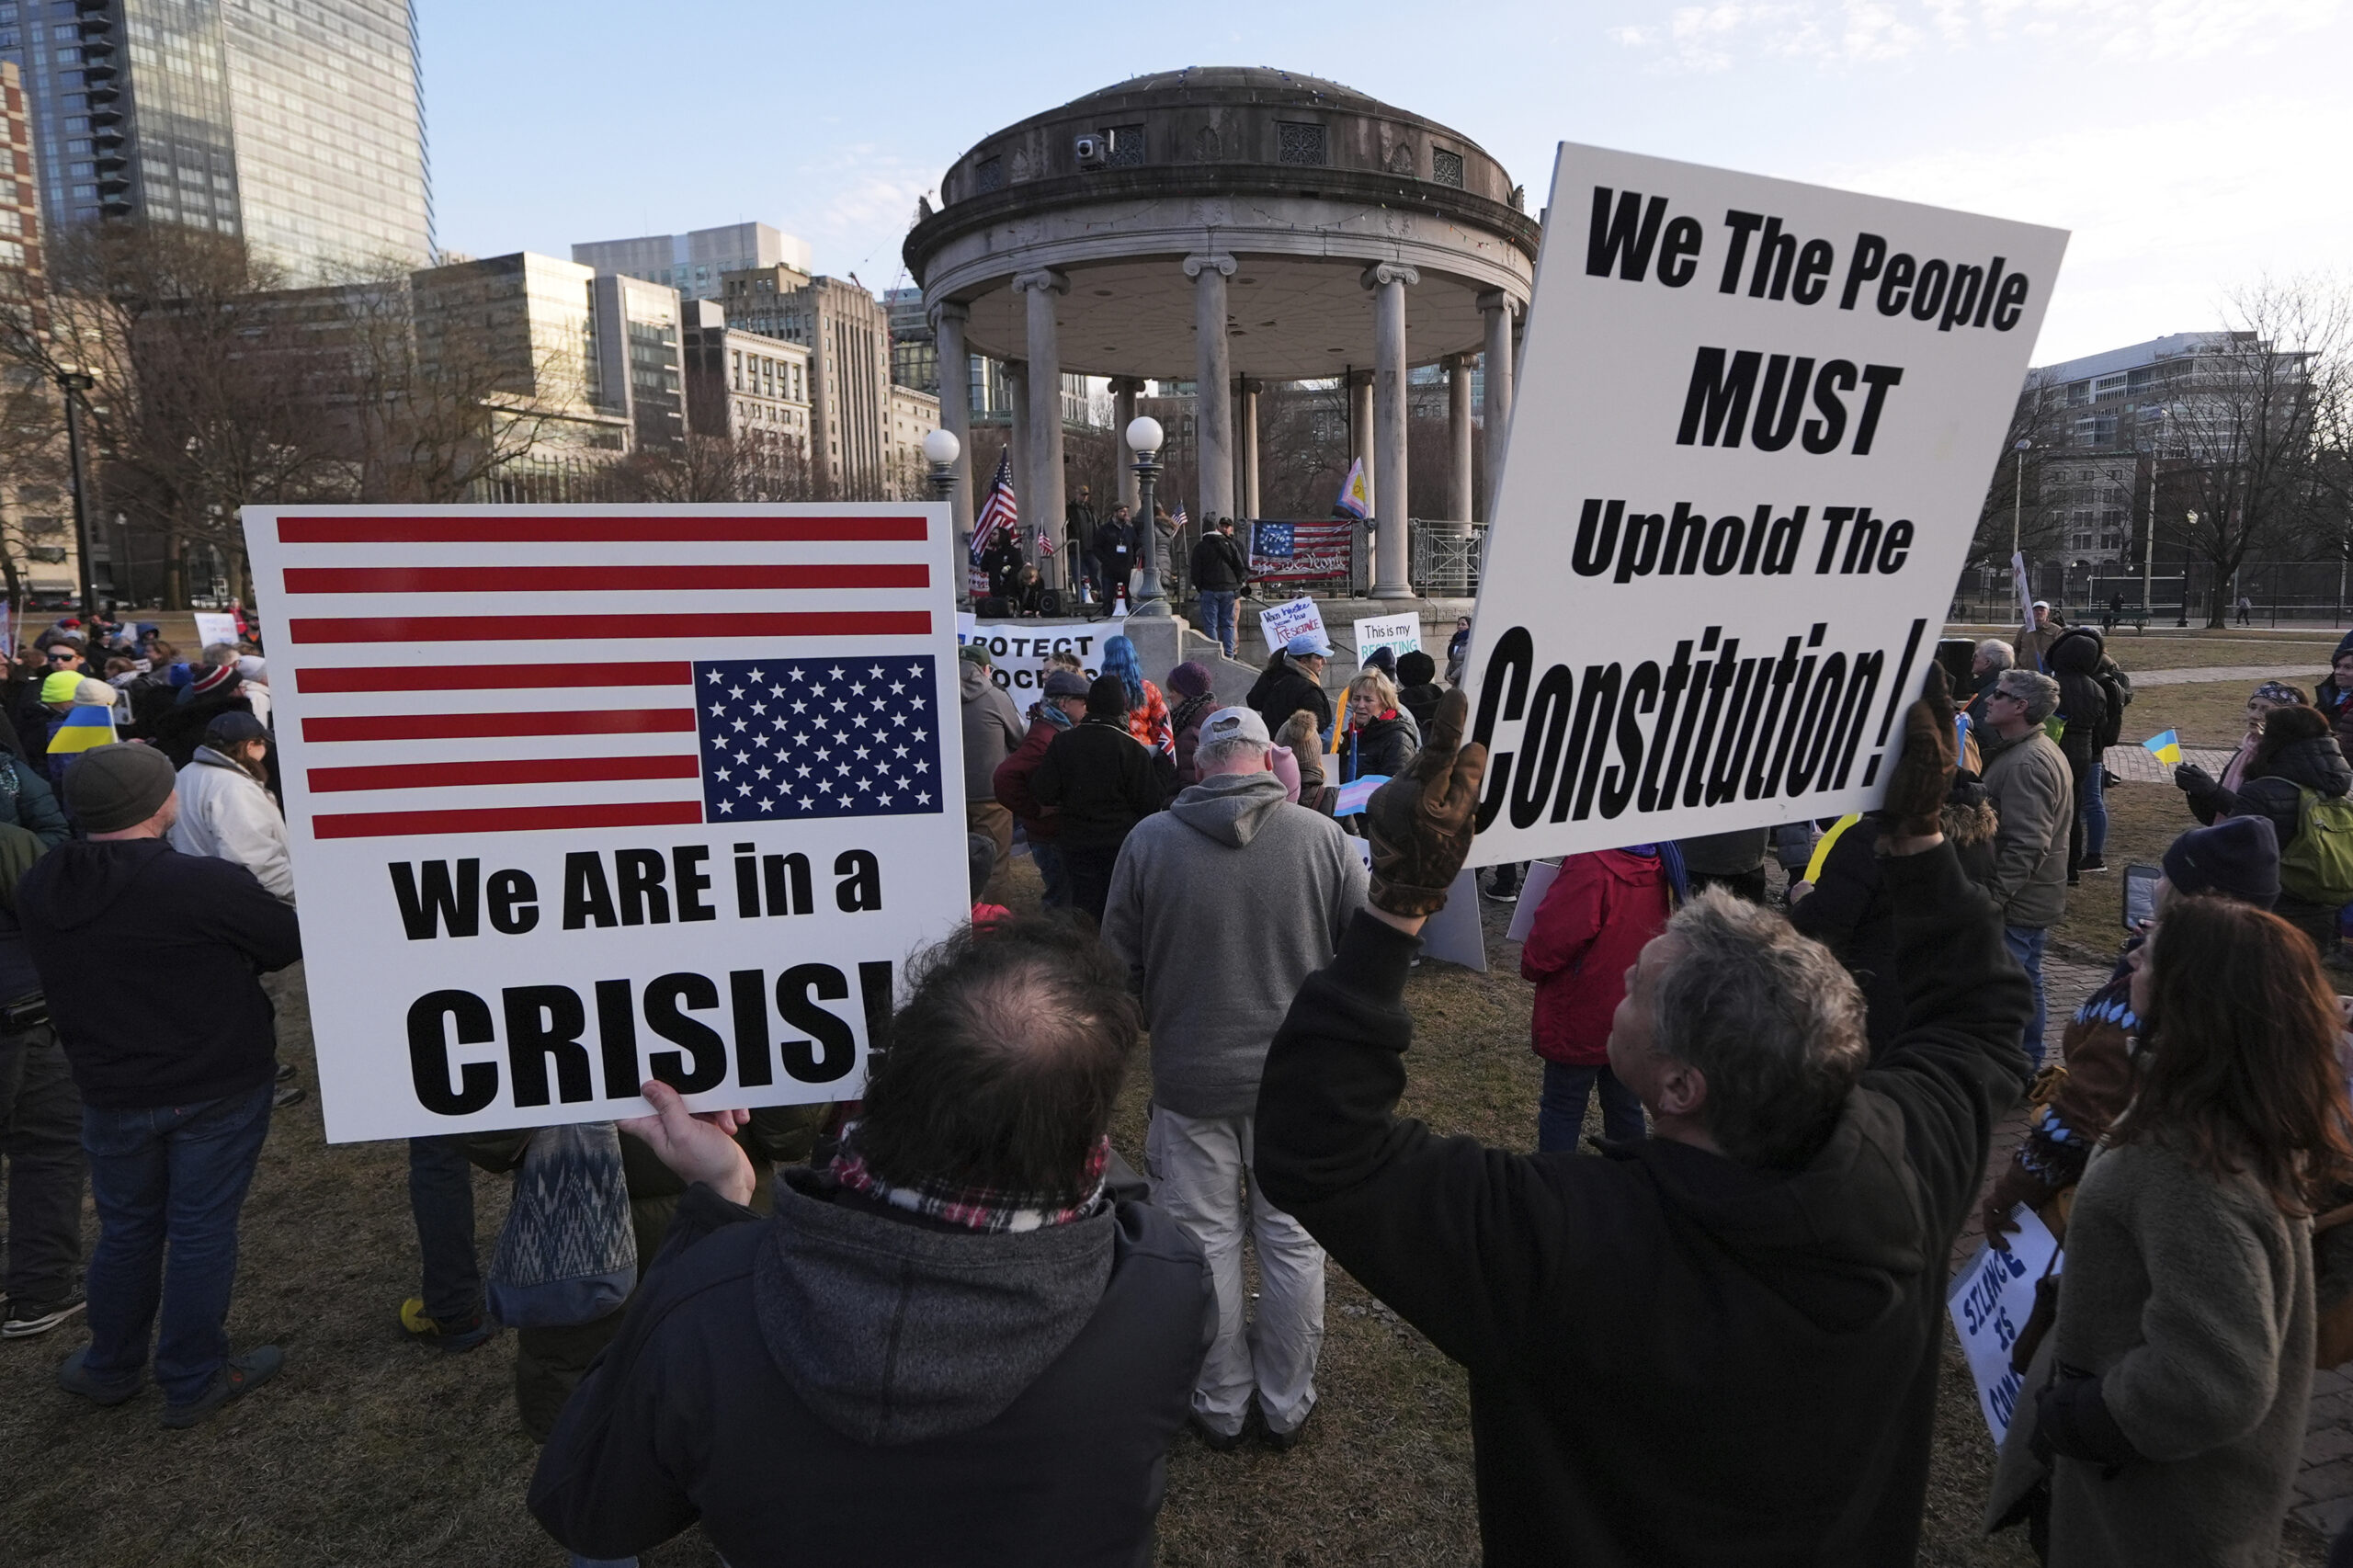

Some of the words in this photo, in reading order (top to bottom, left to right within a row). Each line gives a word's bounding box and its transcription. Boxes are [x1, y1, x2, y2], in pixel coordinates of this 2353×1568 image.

[1586, 187, 1702, 288] We
[1720, 210, 1834, 305] The
[1840, 233, 2028, 332] People
[1677, 347, 1904, 455] MUST
[1264, 533, 1285, 543] 1776
[1572, 499, 1810, 584] Uphold
[1815, 506, 1914, 574] The
[1306, 551, 1347, 574] People
[1274, 619, 1321, 644] RESISTANCE
[1293, 612, 1306, 621] law
[1364, 625, 1386, 639] This
[1386, 625, 1394, 637] is
[1395, 625, 1411, 637] my
[1361, 639, 1418, 659] RETING
[1472, 619, 1927, 835] Constitution!
[388, 858, 539, 940] We
[563, 845, 716, 930] ARE
[733, 842, 813, 918] in
[835, 849, 881, 913] a
[407, 960, 893, 1115] CRISIS!
[1994, 1305, 2017, 1352] IS
